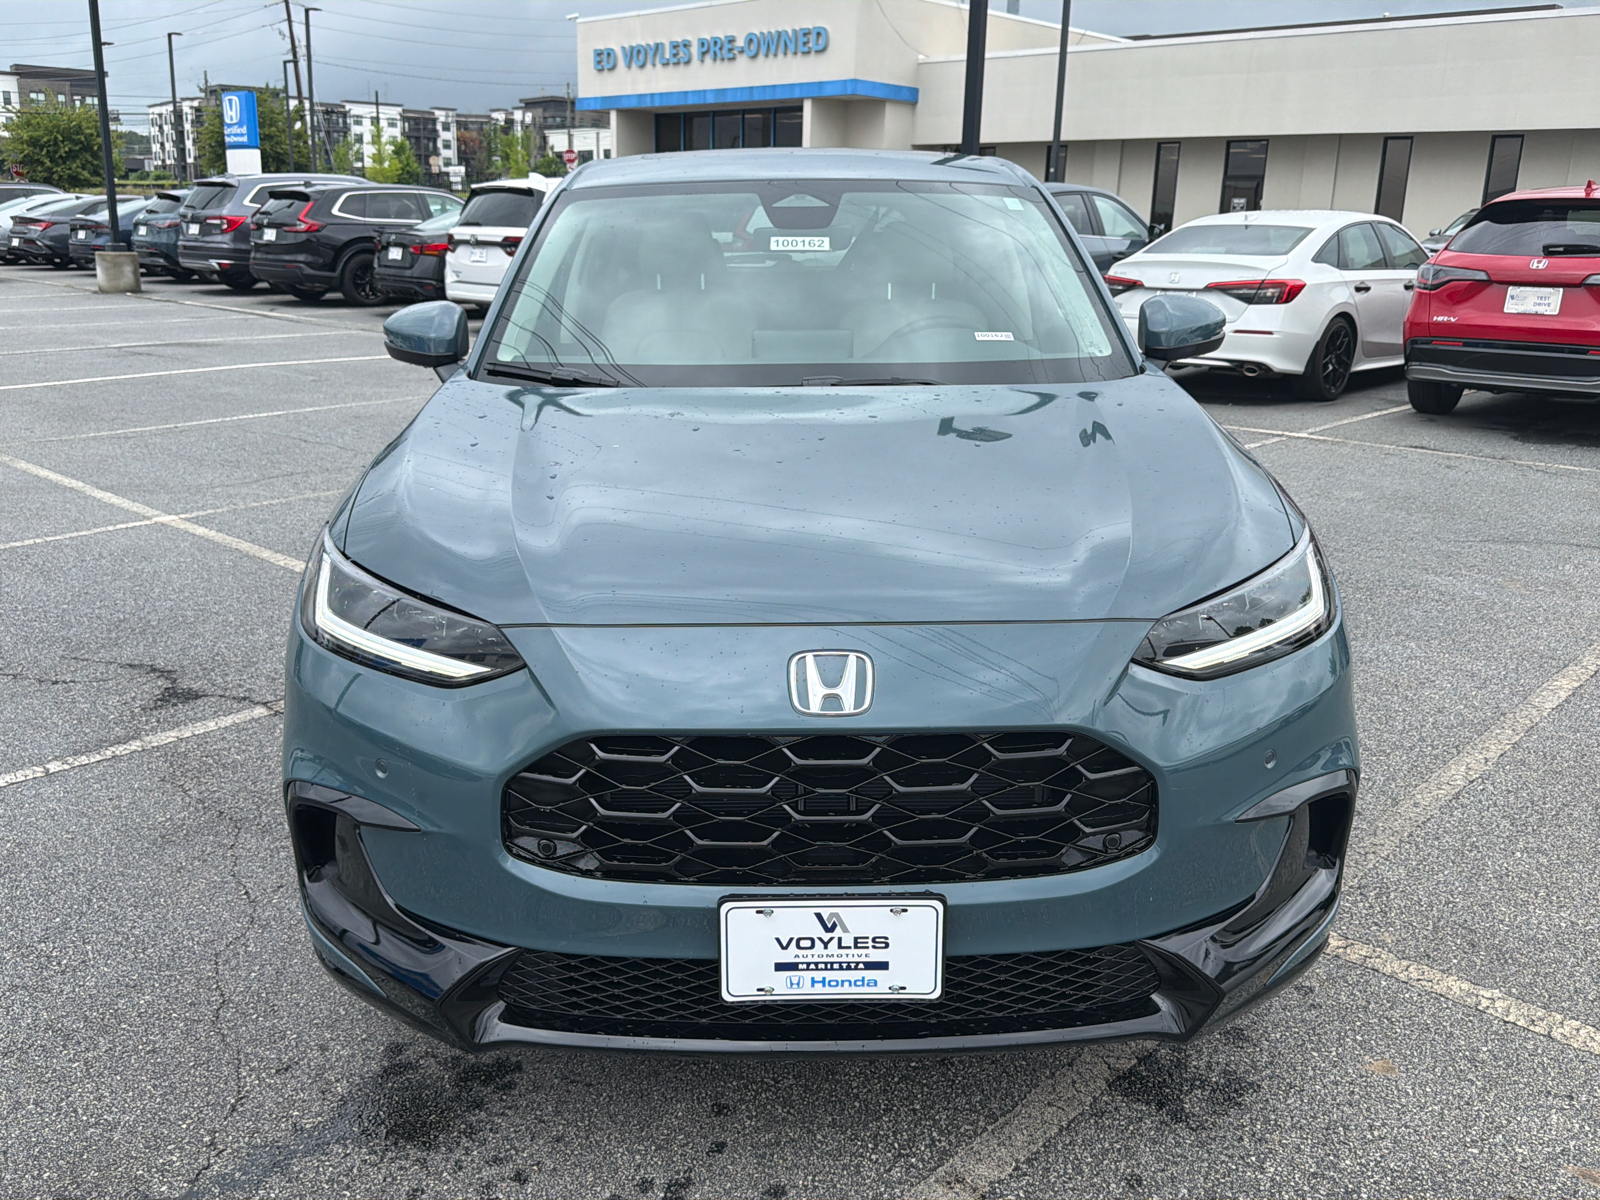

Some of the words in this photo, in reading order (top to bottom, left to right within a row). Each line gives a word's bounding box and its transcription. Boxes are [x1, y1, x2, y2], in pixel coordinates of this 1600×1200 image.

[593, 48, 616, 71] ED
[621, 39, 692, 69] VOYLES
[697, 26, 828, 62] PRE-OWNED
[773, 239, 825, 248] 100162
[774, 936, 890, 951] VOYLES
[798, 962, 865, 970] MARIETTA
[810, 976, 878, 988] Honda
